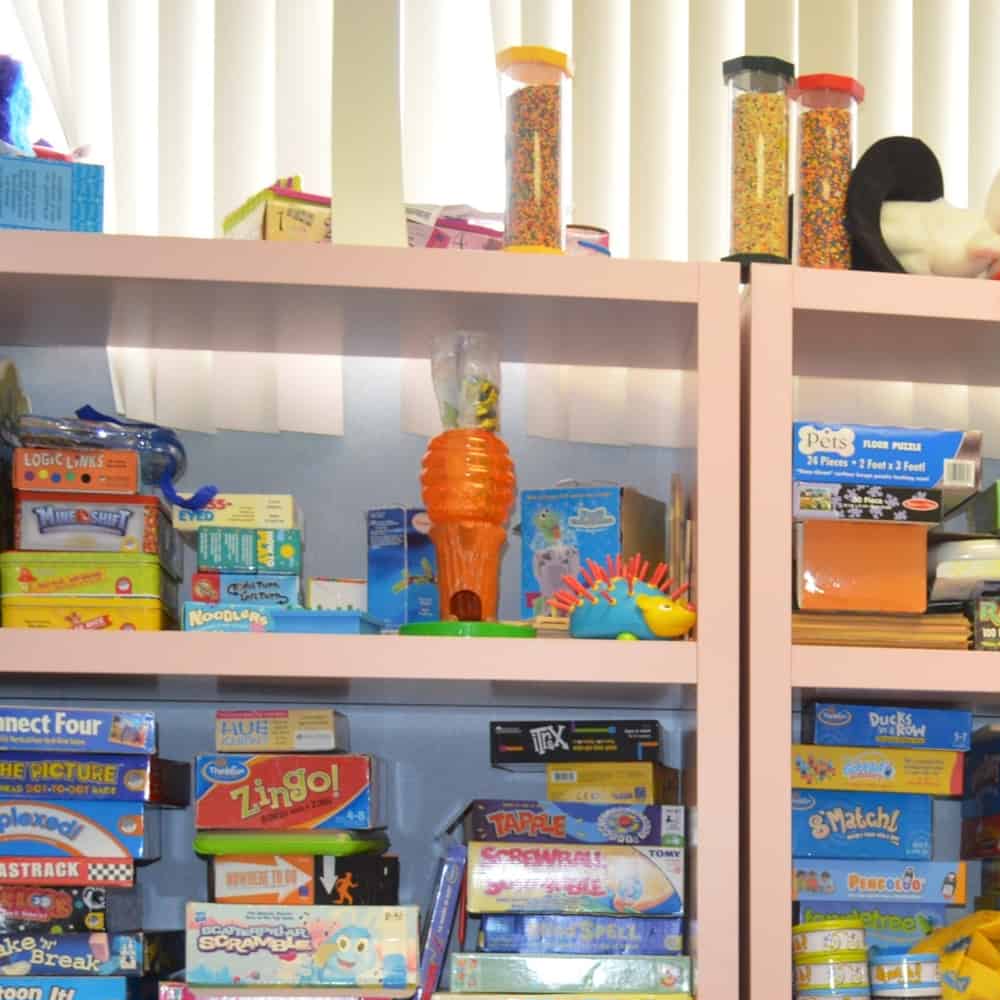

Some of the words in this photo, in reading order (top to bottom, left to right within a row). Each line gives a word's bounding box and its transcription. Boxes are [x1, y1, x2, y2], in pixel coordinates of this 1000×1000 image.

[806, 431, 849, 450] Pets
[55, 712, 102, 736] Four
[31, 762, 118, 783] PICTURE
[230, 764, 340, 820] Zingo!
[487, 810, 568, 838] TAPPLE
[649, 850, 681, 858] TOMY
[31, 949, 101, 972] Break
